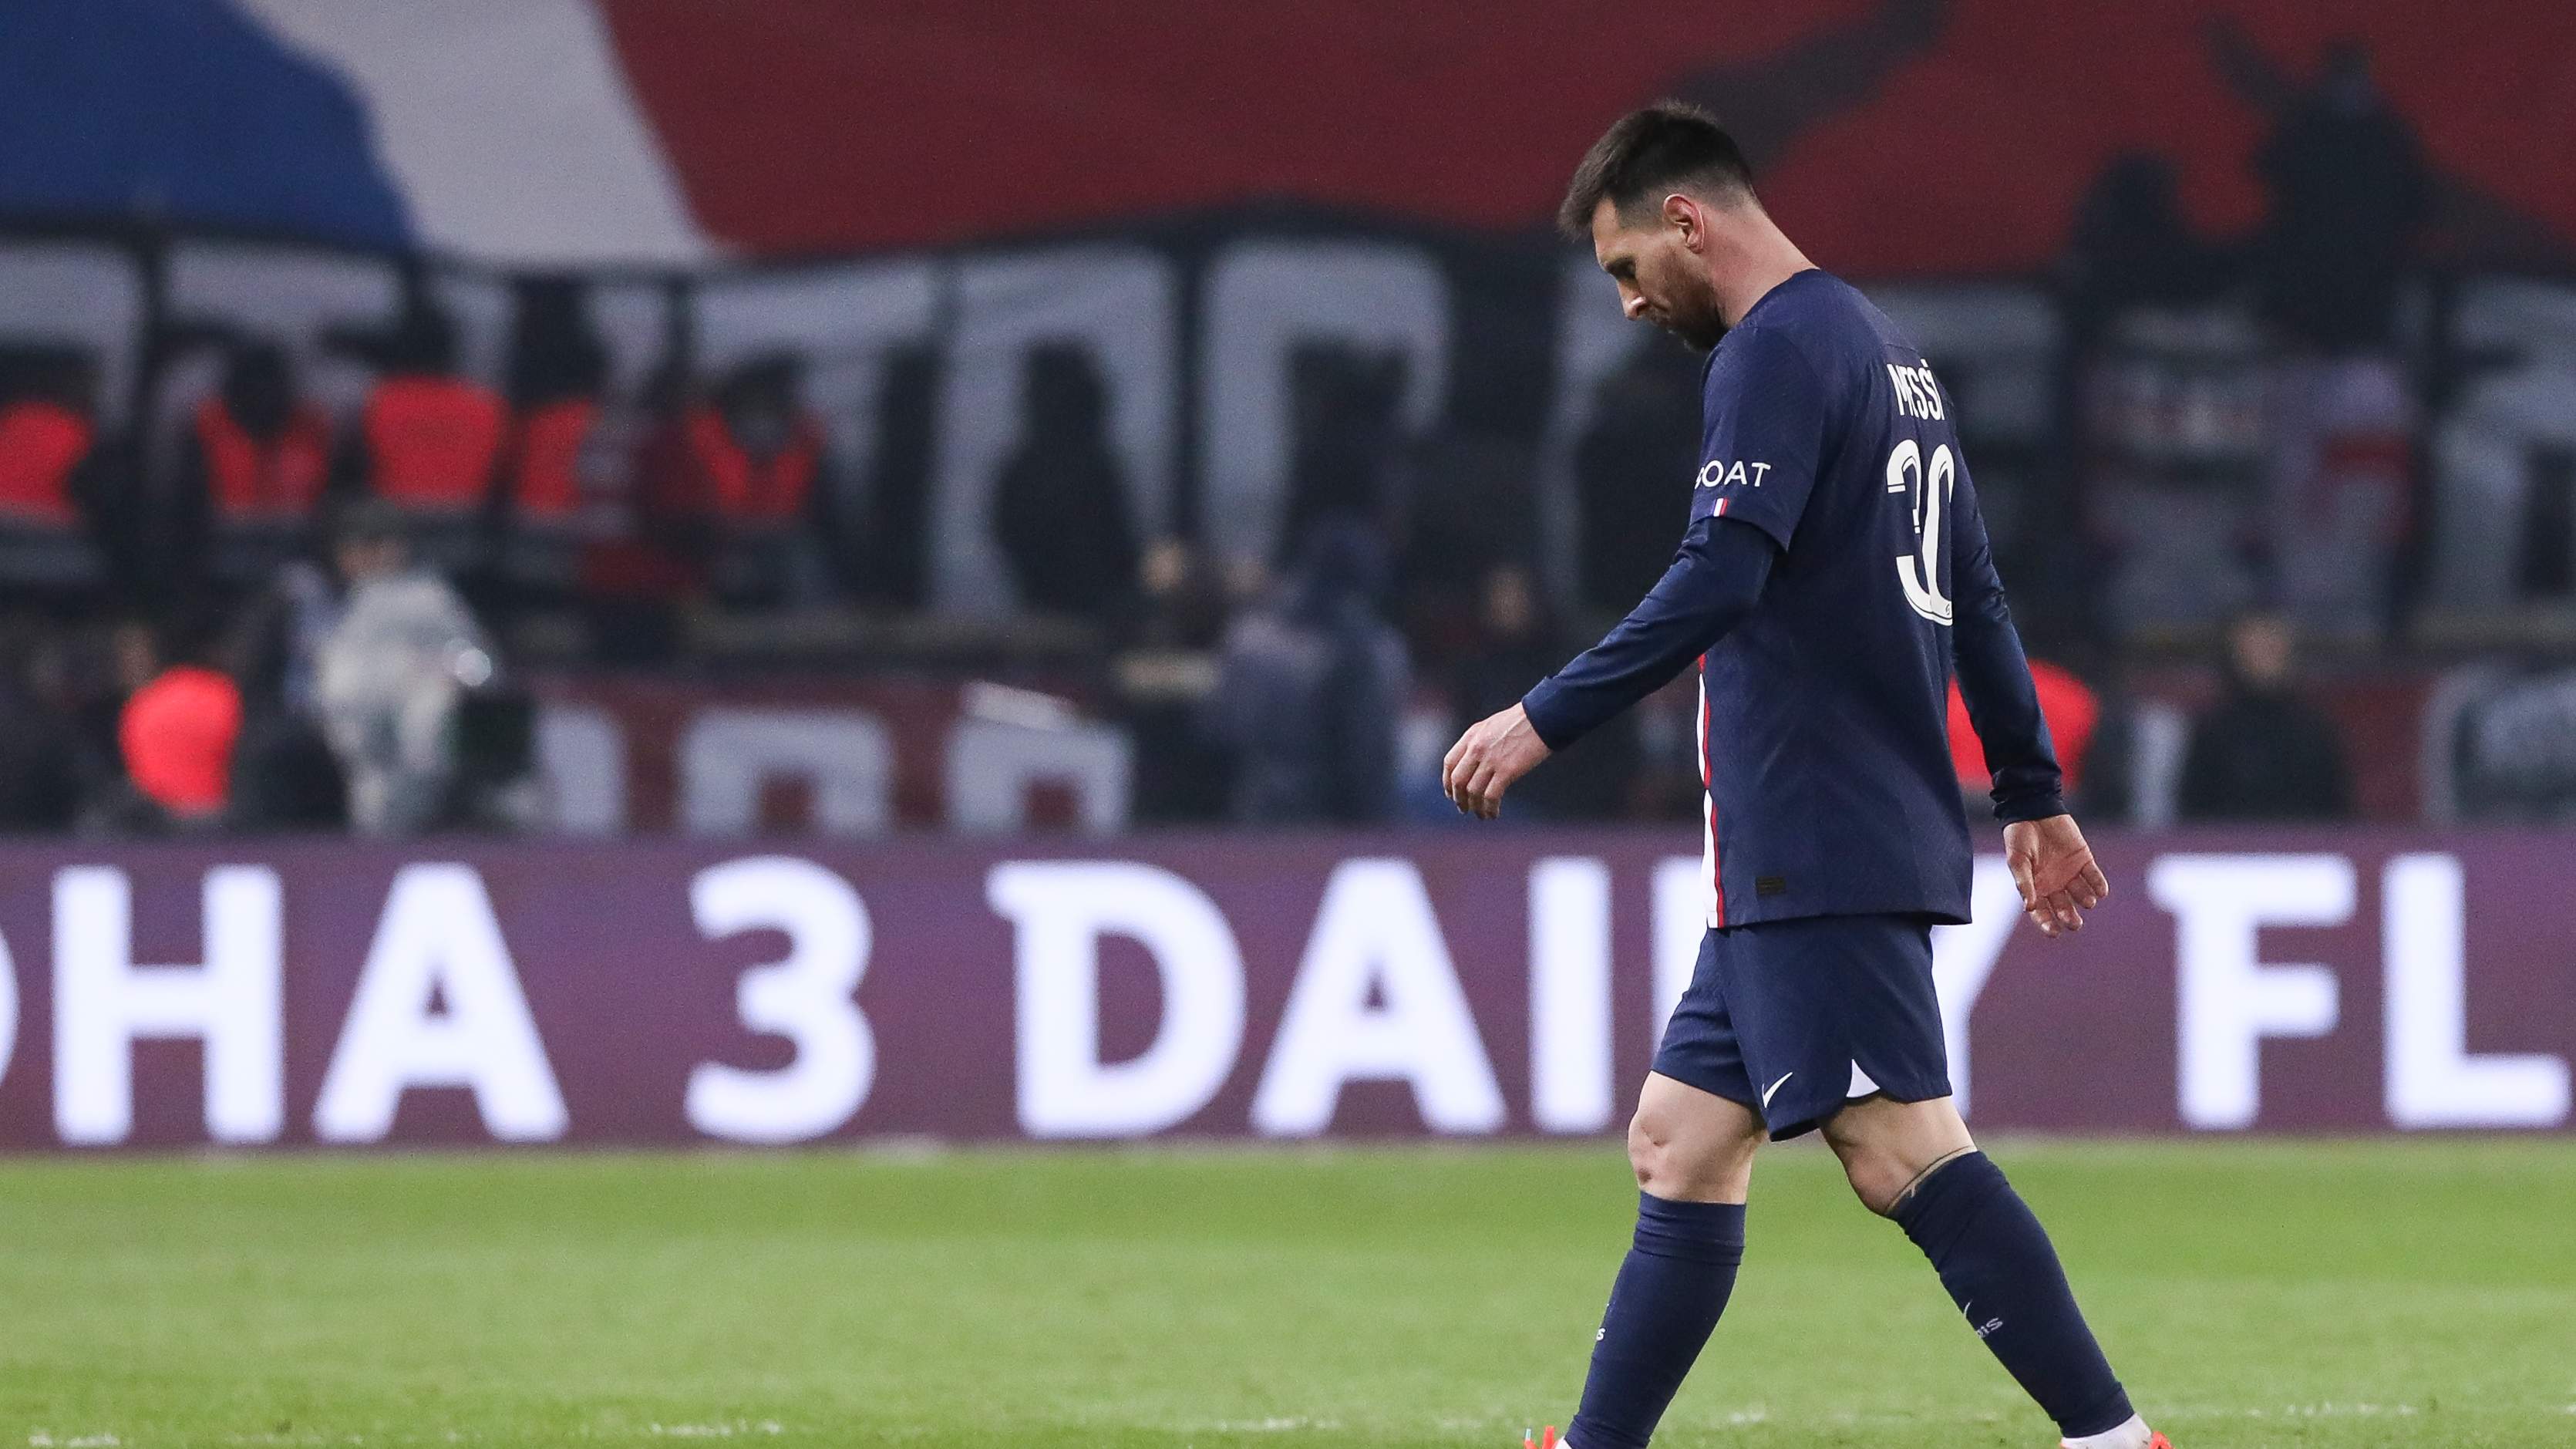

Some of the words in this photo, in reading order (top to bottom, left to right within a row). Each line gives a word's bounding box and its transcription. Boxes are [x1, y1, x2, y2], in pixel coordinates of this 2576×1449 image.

[1886, 439, 1955, 626] 30
[0, 862, 571, 1146] HA
[683, 854, 877, 1144] 3
[984, 856, 2028, 1135] DAI
[2145, 852, 2572, 1130] FL
